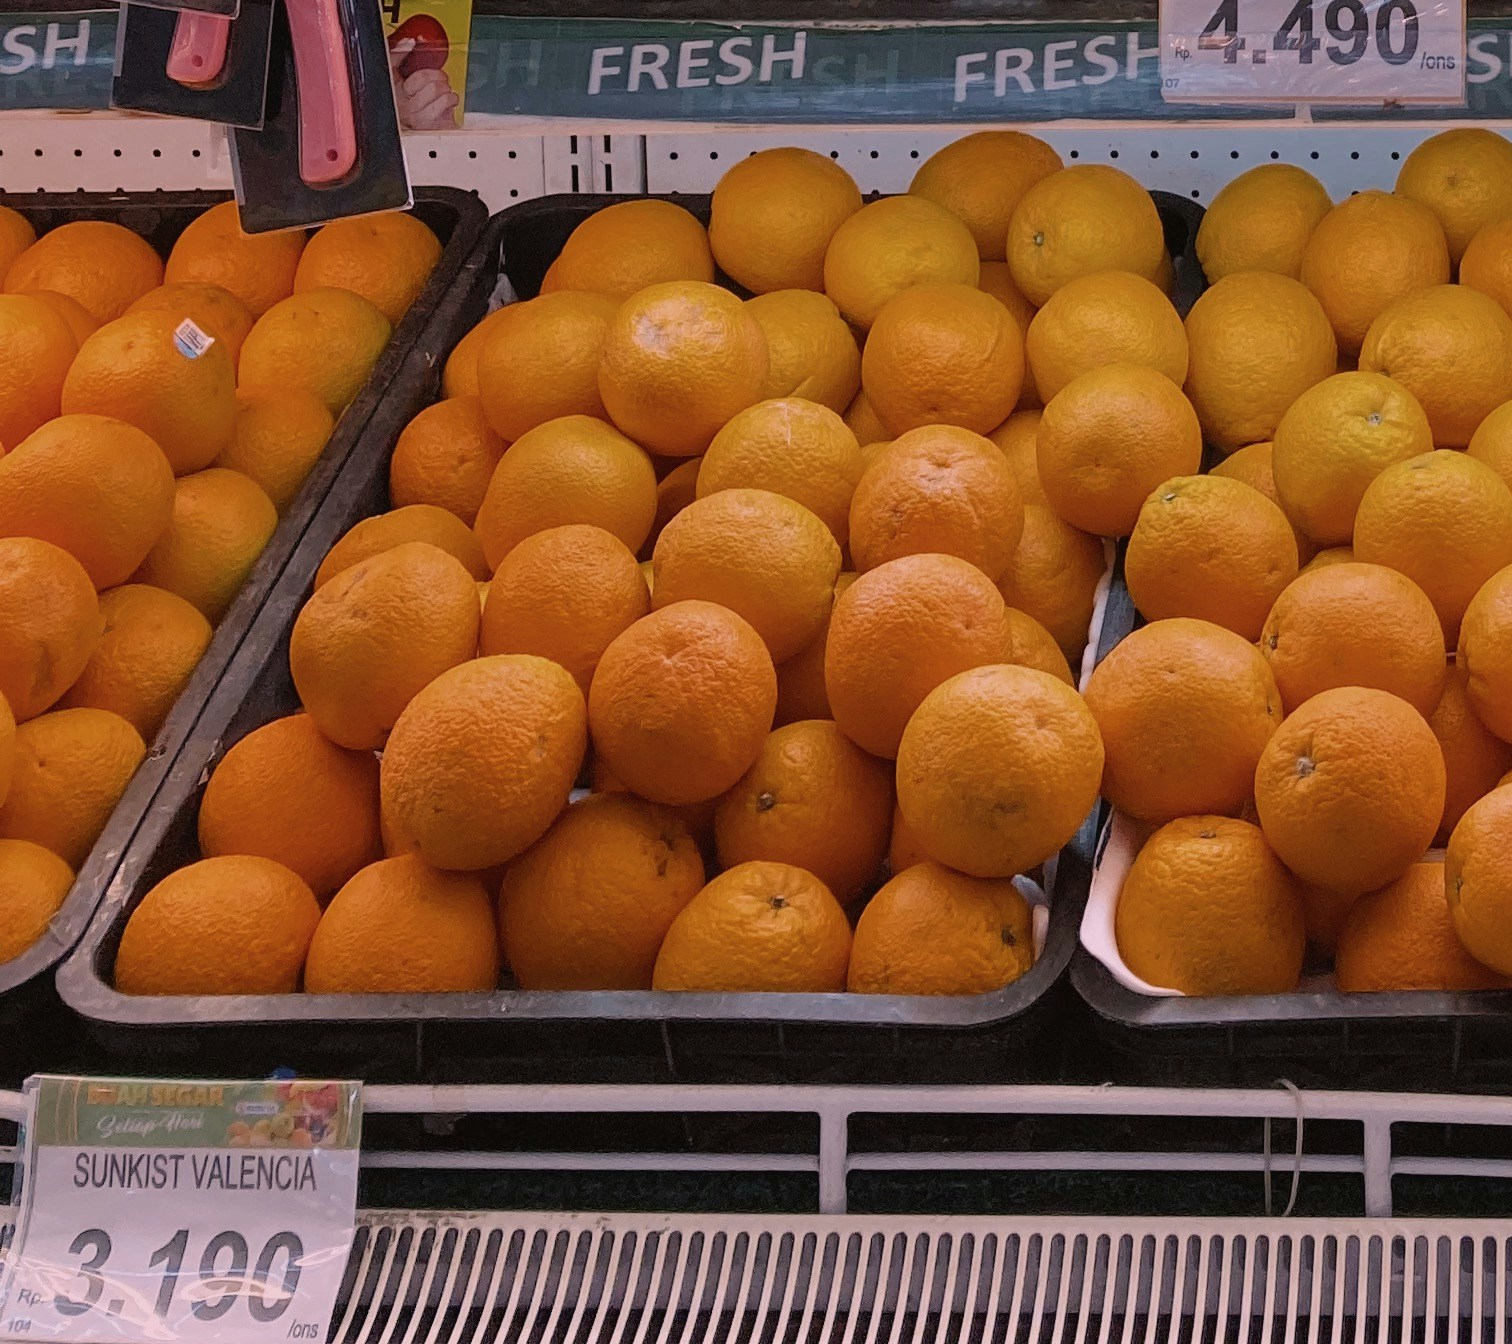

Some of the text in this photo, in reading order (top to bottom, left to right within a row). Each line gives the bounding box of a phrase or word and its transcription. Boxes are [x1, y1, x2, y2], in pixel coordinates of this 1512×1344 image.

[586, 31, 807, 96] FRESH
[1419, 50, 1456, 71] /ons
[73, 1152, 318, 1191] SUNKIST VALENCIA
[53, 1228, 304, 1322] 3.190
[287, 1319, 319, 1339] /ons
